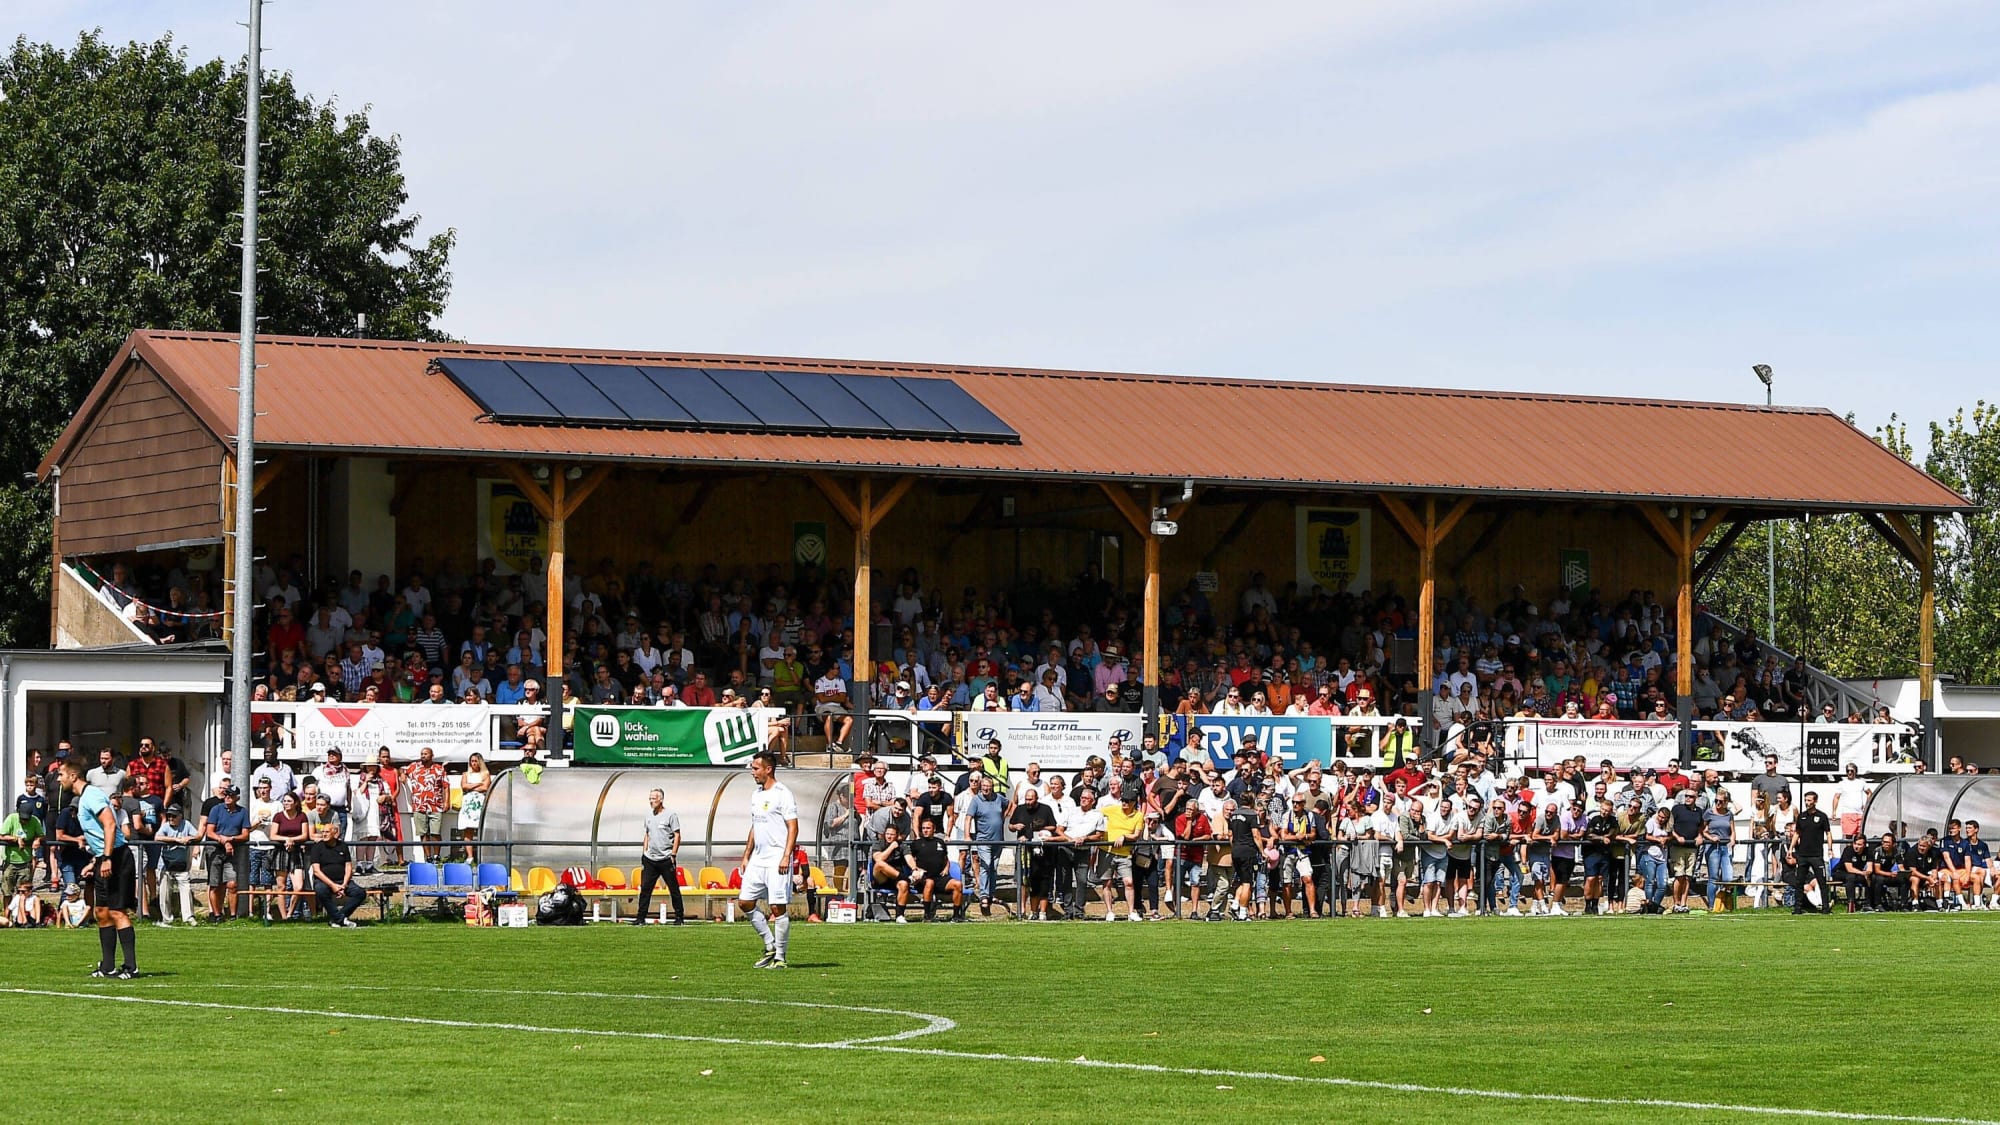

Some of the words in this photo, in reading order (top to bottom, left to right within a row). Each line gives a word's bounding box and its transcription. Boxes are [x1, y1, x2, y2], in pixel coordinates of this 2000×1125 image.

[520, 537, 537, 547] FC
[1333, 560, 1346, 569] FC
[1031, 720, 1079, 731] Sazma
[309, 731, 380, 739] GEUENICH
[624, 731, 659, 741] wahlen
[1008, 733, 1039, 741] Autohaus
[1040, 733, 1062, 741] Rudolf
[1064, 733, 1086, 741] Sazma
[1544, 728, 1610, 739] CHRISTOPH
[1613, 727, 1676, 739] RÜHLMANN
[309, 740, 380, 748] BEDACHUNGEN
[1199, 725, 1298, 760] RWE
[1810, 737, 1837, 745] PUSH
[1810, 747, 1837, 755] ATHLETIK
